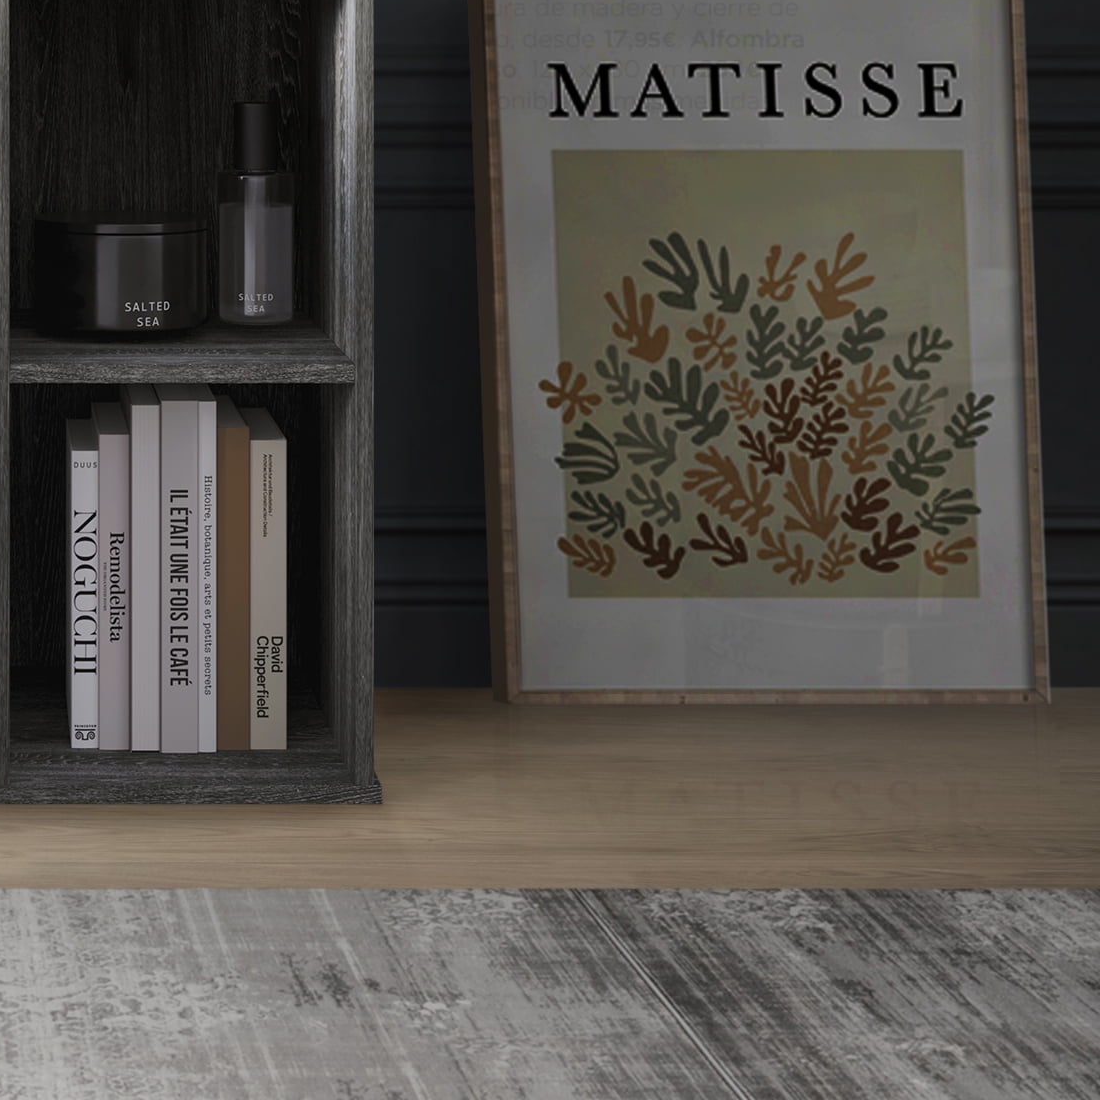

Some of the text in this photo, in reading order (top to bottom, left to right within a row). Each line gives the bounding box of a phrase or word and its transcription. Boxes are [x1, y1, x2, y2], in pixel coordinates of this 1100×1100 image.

[548, 63, 963, 118] MATISSE
[124, 301, 171, 312] SALTED
[238, 292, 274, 301] SALTED
[247, 304, 265, 313] SEA
[136, 317, 160, 327] SEA
[73, 461, 98, 469] DUUS
[73, 510, 98, 676] NOGUCHI
[109, 531, 125, 643] Remodelista
[169, 489, 193, 687] IL ÉTAIT UNE FOIS LE CAFÉ
[202, 475, 214, 696] Histoire, botanique, arts et petits secrets
[254, 635, 269, 719] Chipperfield
[270, 635, 283, 673] David
